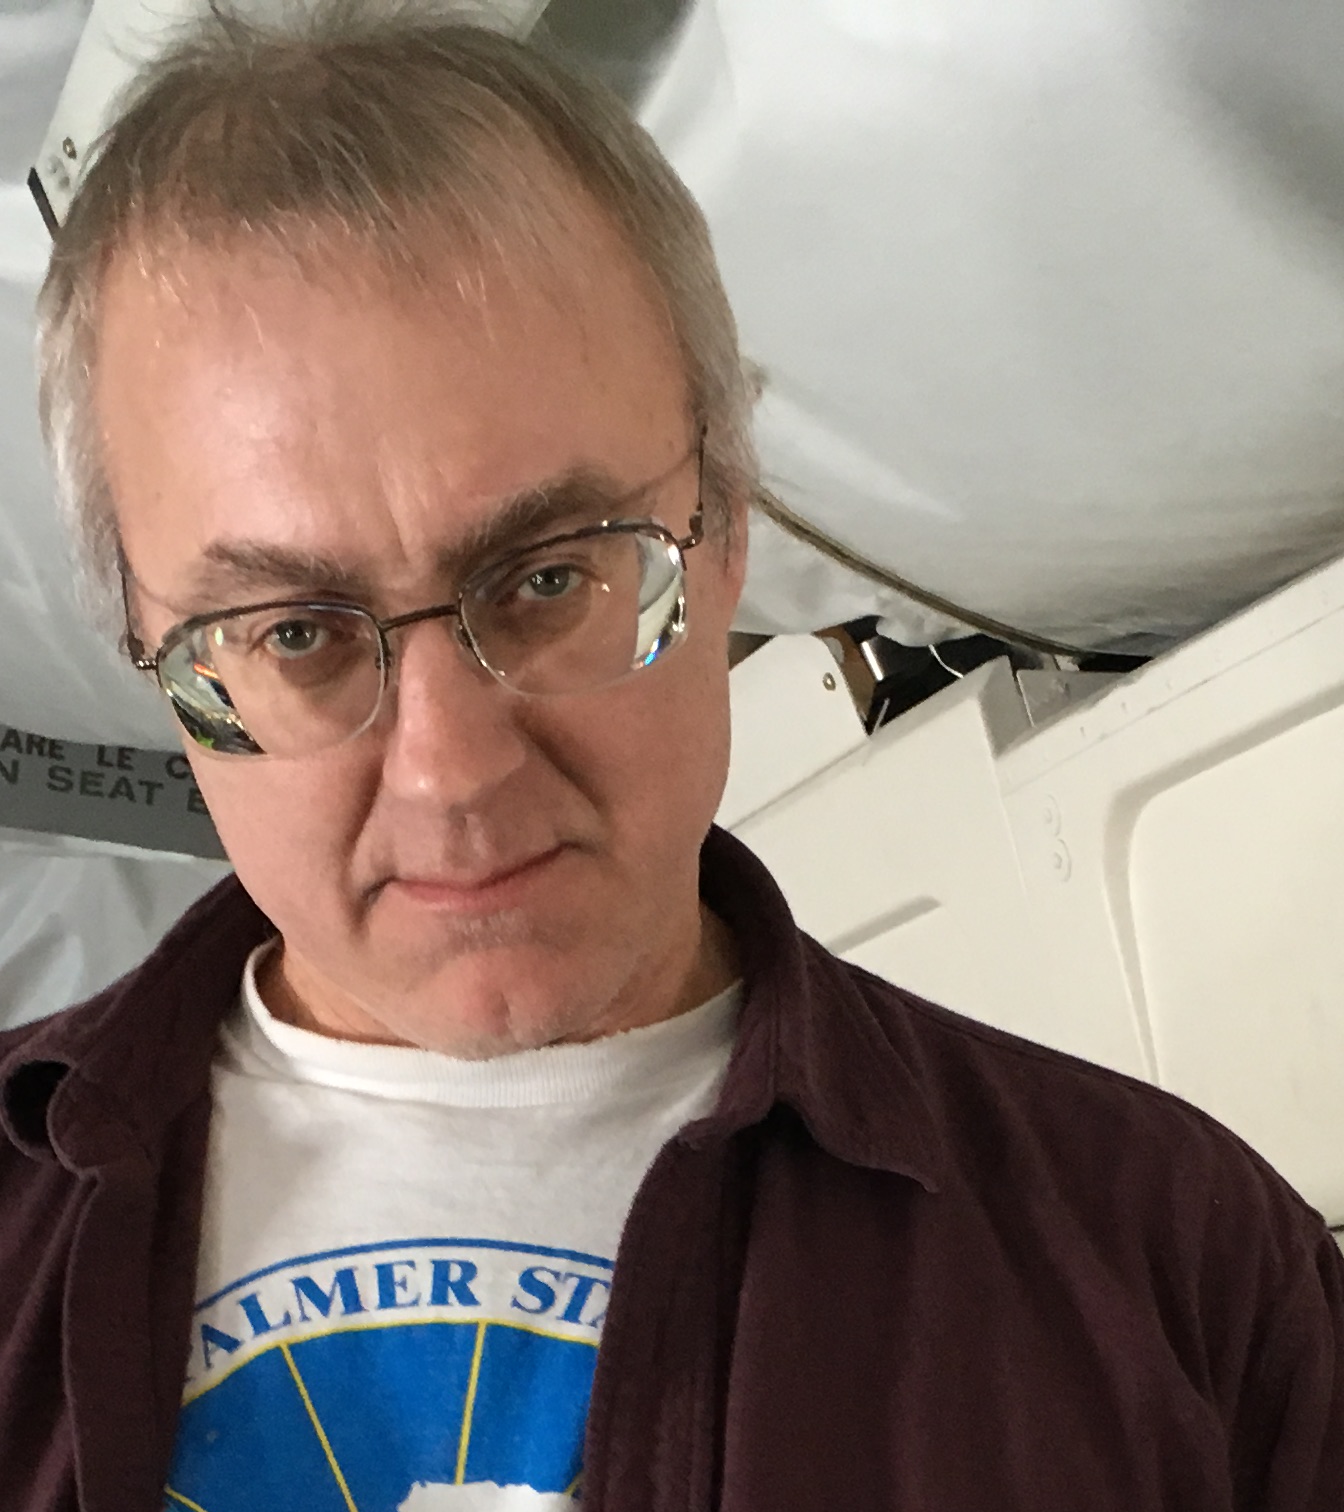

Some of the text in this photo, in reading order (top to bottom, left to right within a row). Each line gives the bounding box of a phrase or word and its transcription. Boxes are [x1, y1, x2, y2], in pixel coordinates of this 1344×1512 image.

[96, 744, 135, 772] LE
[47, 766, 164, 807] SEAT
[197, 1258, 482, 1370] ALMER
